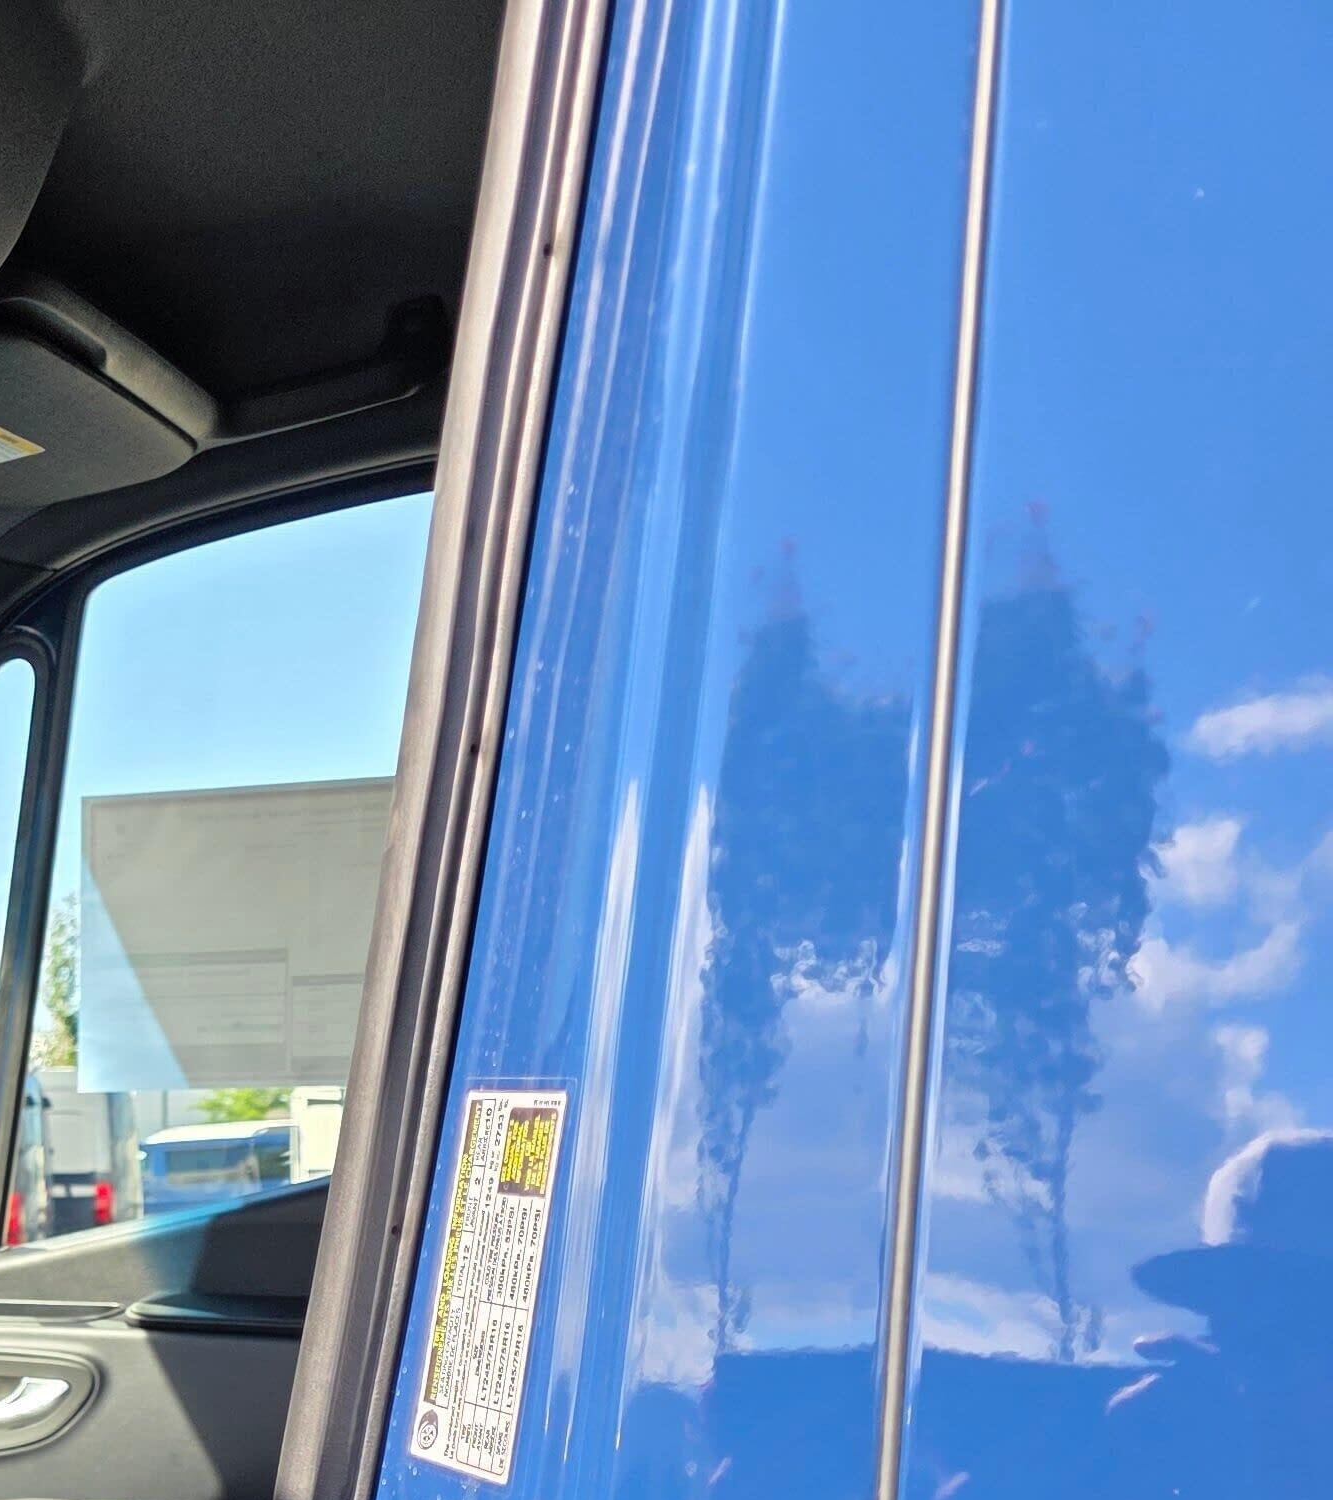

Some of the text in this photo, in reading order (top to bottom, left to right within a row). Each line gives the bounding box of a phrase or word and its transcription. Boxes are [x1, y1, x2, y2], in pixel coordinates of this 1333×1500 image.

[465, 1103, 481, 1177] CHARGEMENT
[485, 1107, 492, 1121] 10
[474, 1176, 480, 1185] 2
[437, 1292, 446, 1317] AND
[451, 1153, 468, 1230] INFORMATION
[456, 1244, 470, 1291] TOTAL 12
[492, 1321, 511, 1405] LT245/75R16
